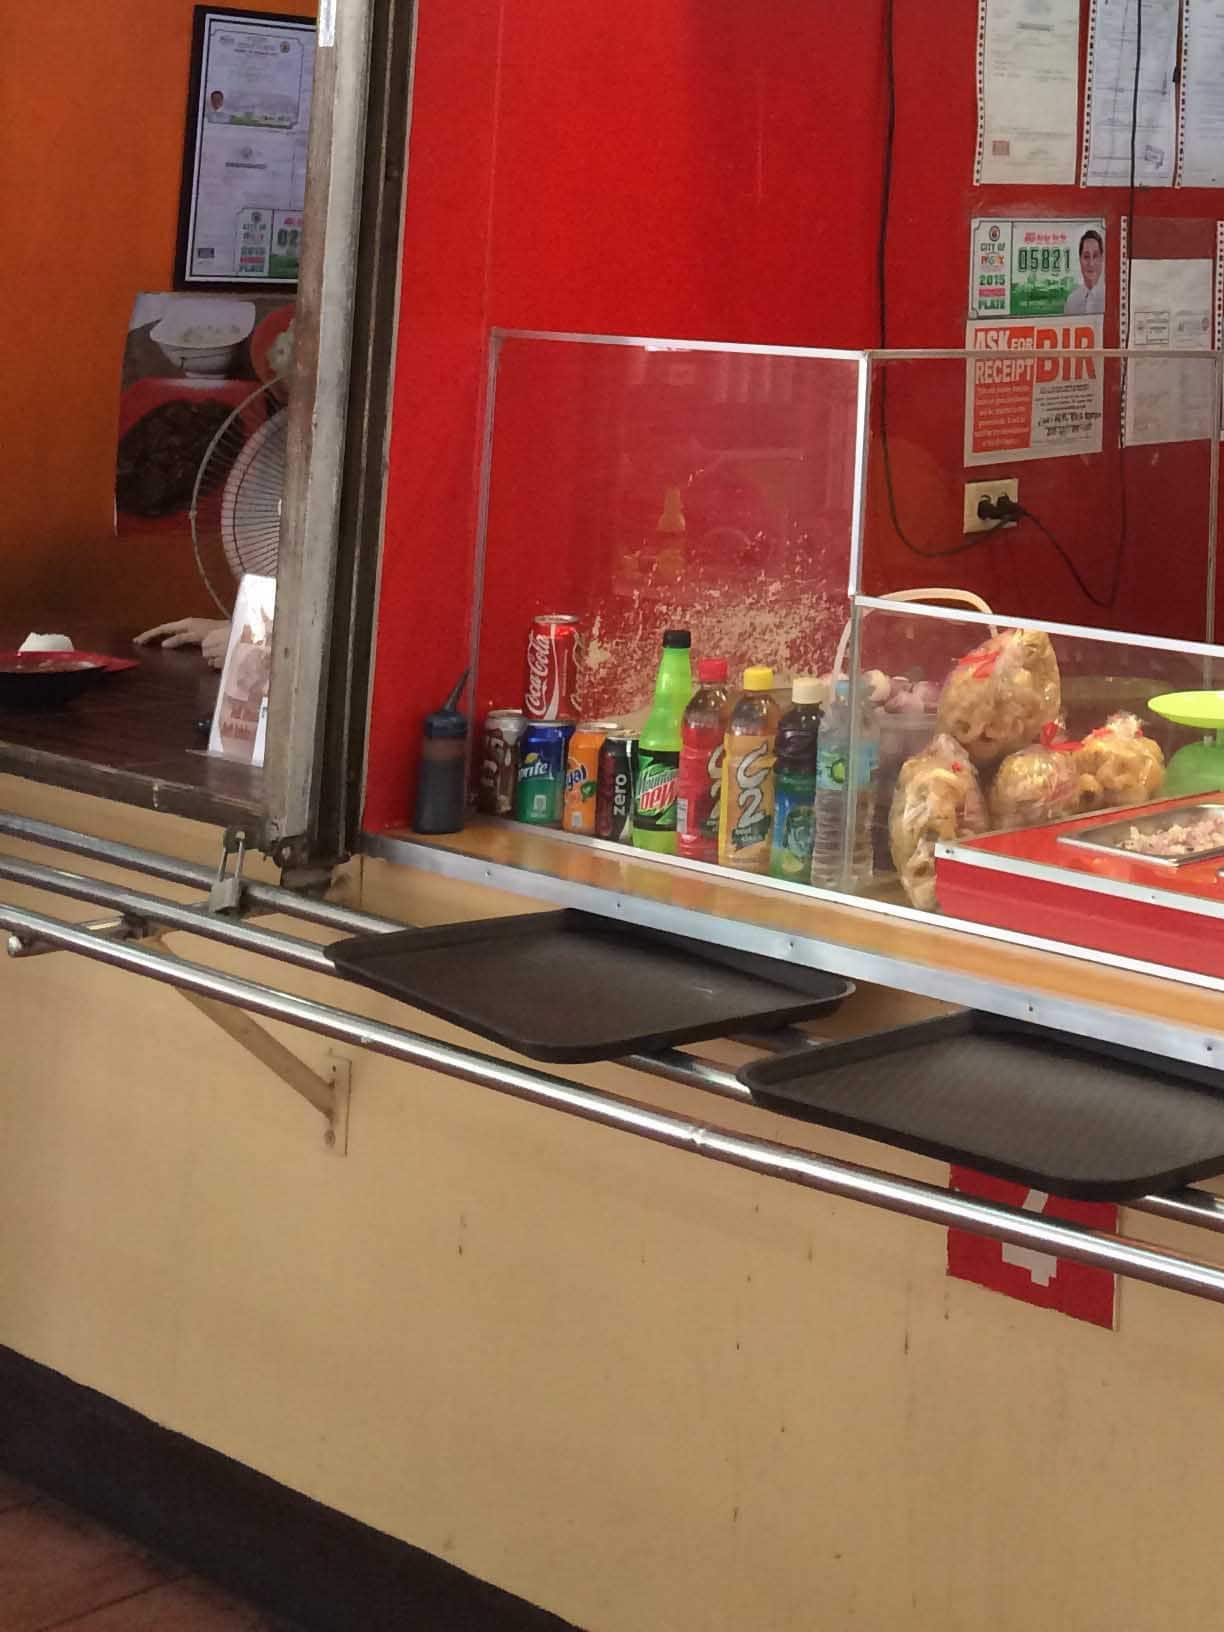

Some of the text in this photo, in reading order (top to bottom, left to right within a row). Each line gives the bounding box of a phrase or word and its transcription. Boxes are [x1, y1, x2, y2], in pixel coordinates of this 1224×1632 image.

[1018, 248, 1071, 272] 05821
[976, 329, 1033, 350] ASK FOR
[1036, 327, 1096, 383] BIR
[975, 359, 1034, 384] RECEIPT
[613, 775, 626, 816] zero
